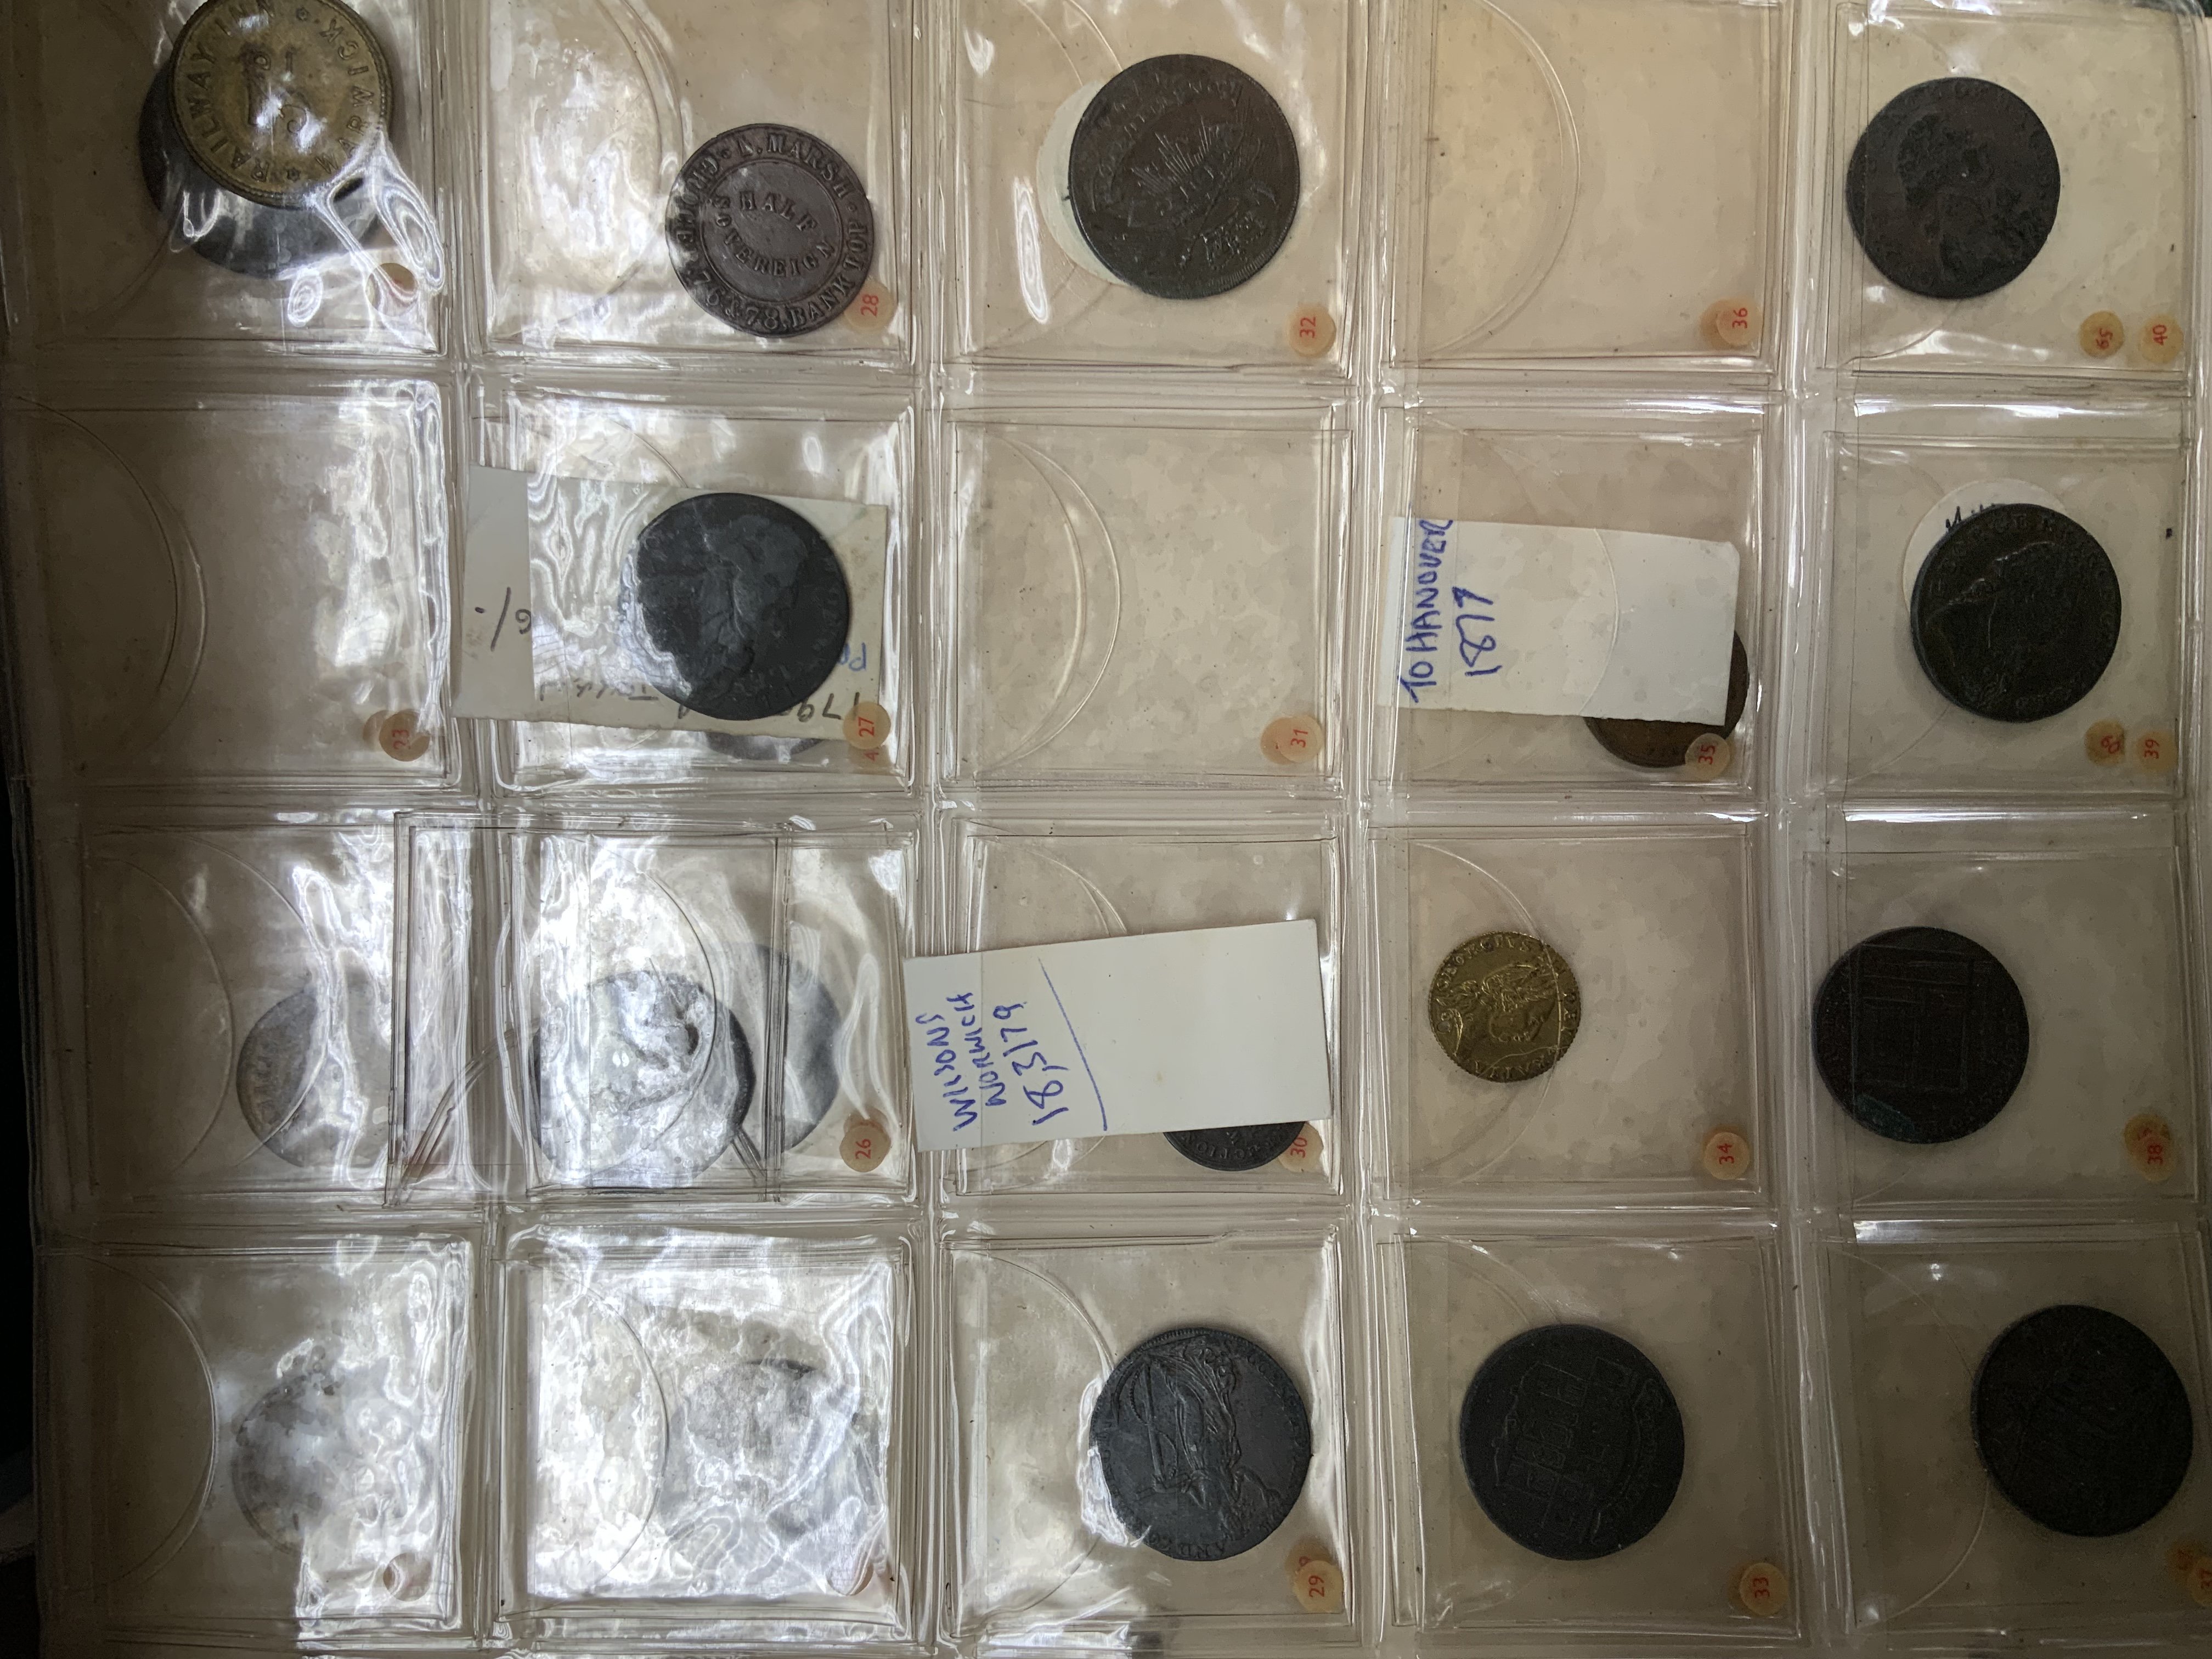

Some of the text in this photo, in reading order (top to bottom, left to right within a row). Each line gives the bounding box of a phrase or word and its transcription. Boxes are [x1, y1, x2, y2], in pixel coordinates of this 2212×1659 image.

[315, 17, 375, 174] WARWICK
[186, 42, 268, 183] RAILWAY
[768, 133, 850, 198] MARSH
[741, 191, 818, 232] HALF
[713, 194, 835, 276] SOVEREIGN
[789, 274, 855, 328] BANK
[843, 221, 868, 271] TOP
[860, 294, 879, 317] 28
[1299, 317, 1316, 338] 32
[1731, 307, 1748, 328] 36
[2152, 324, 2167, 345] 40
[1398, 519, 1454, 703] TO HANOVER
[858, 716, 874, 737] 27
[1290, 728, 1308, 747] 31
[1699, 744, 1716, 765] 35
[2144, 739, 2160, 759] 39
[946, 992, 1006, 1107] NORWICH
[915, 1013, 978, 1131] WILSONS
[855, 1138, 871, 1159] 26
[1290, 1136, 1307, 1159] 30
[1717, 1143, 1735, 1163] 34
[2147, 1143, 2163, 1165] 38
[1308, 1575, 1325, 1598] 29
[1753, 1577, 1770, 1599] 33
